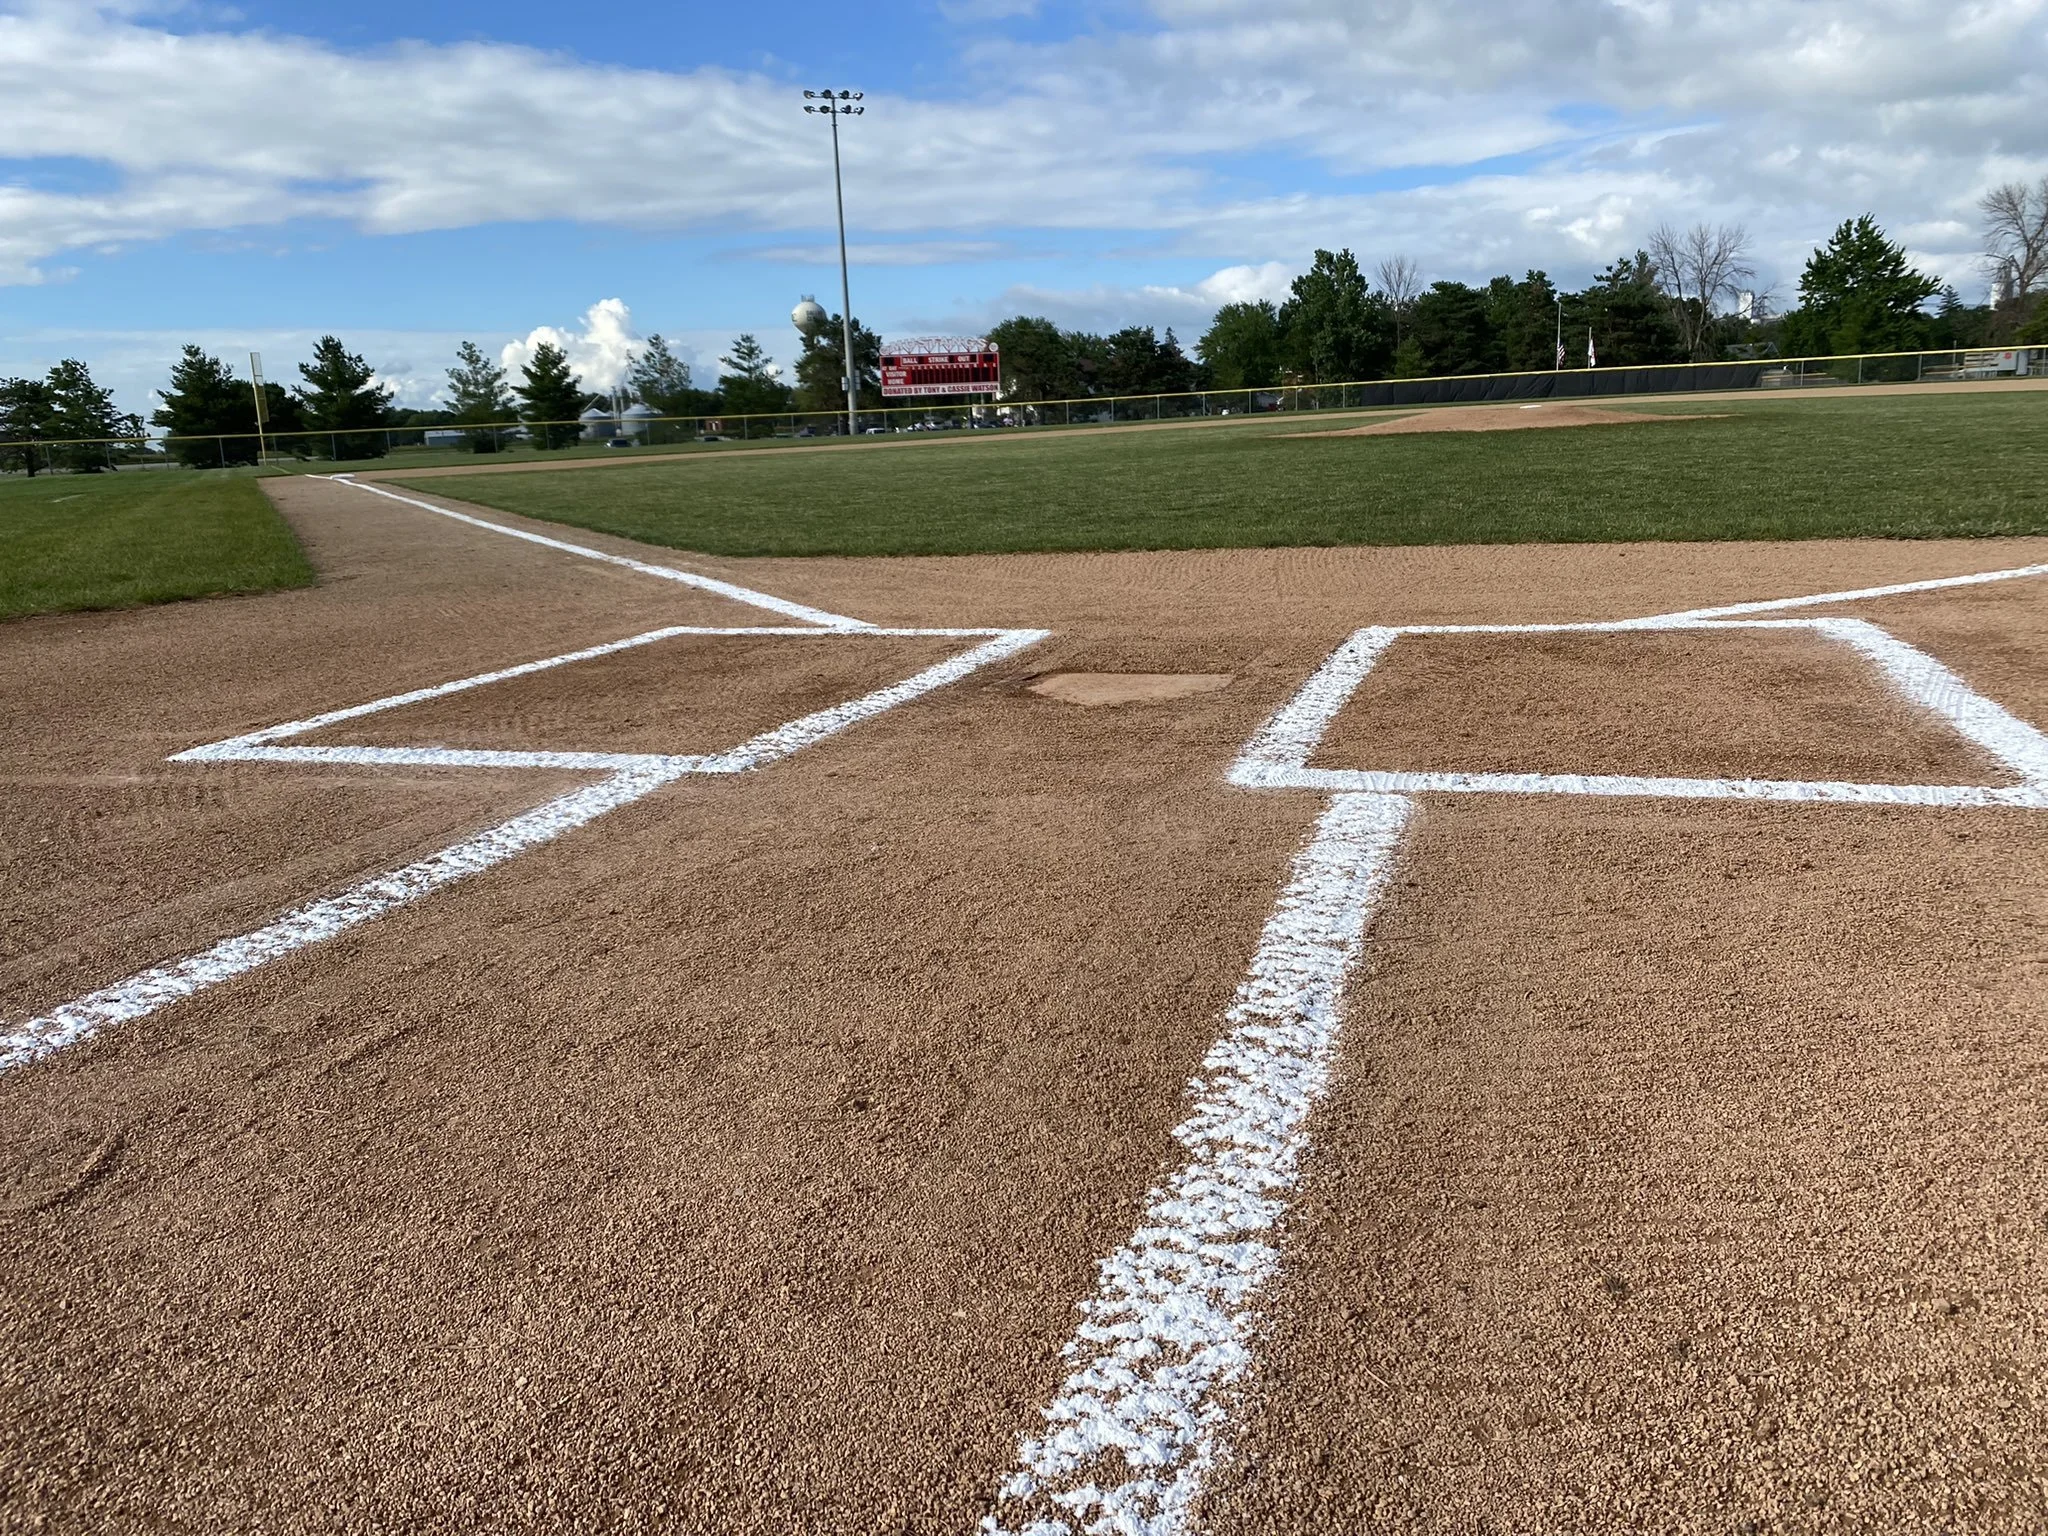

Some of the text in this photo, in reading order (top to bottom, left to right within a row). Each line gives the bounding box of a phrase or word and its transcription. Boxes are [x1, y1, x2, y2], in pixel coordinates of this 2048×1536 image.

[889, 337, 987, 353] MUSTANGS
[947, 385, 970, 393] CASSIE
[971, 384, 998, 392] WATSON
